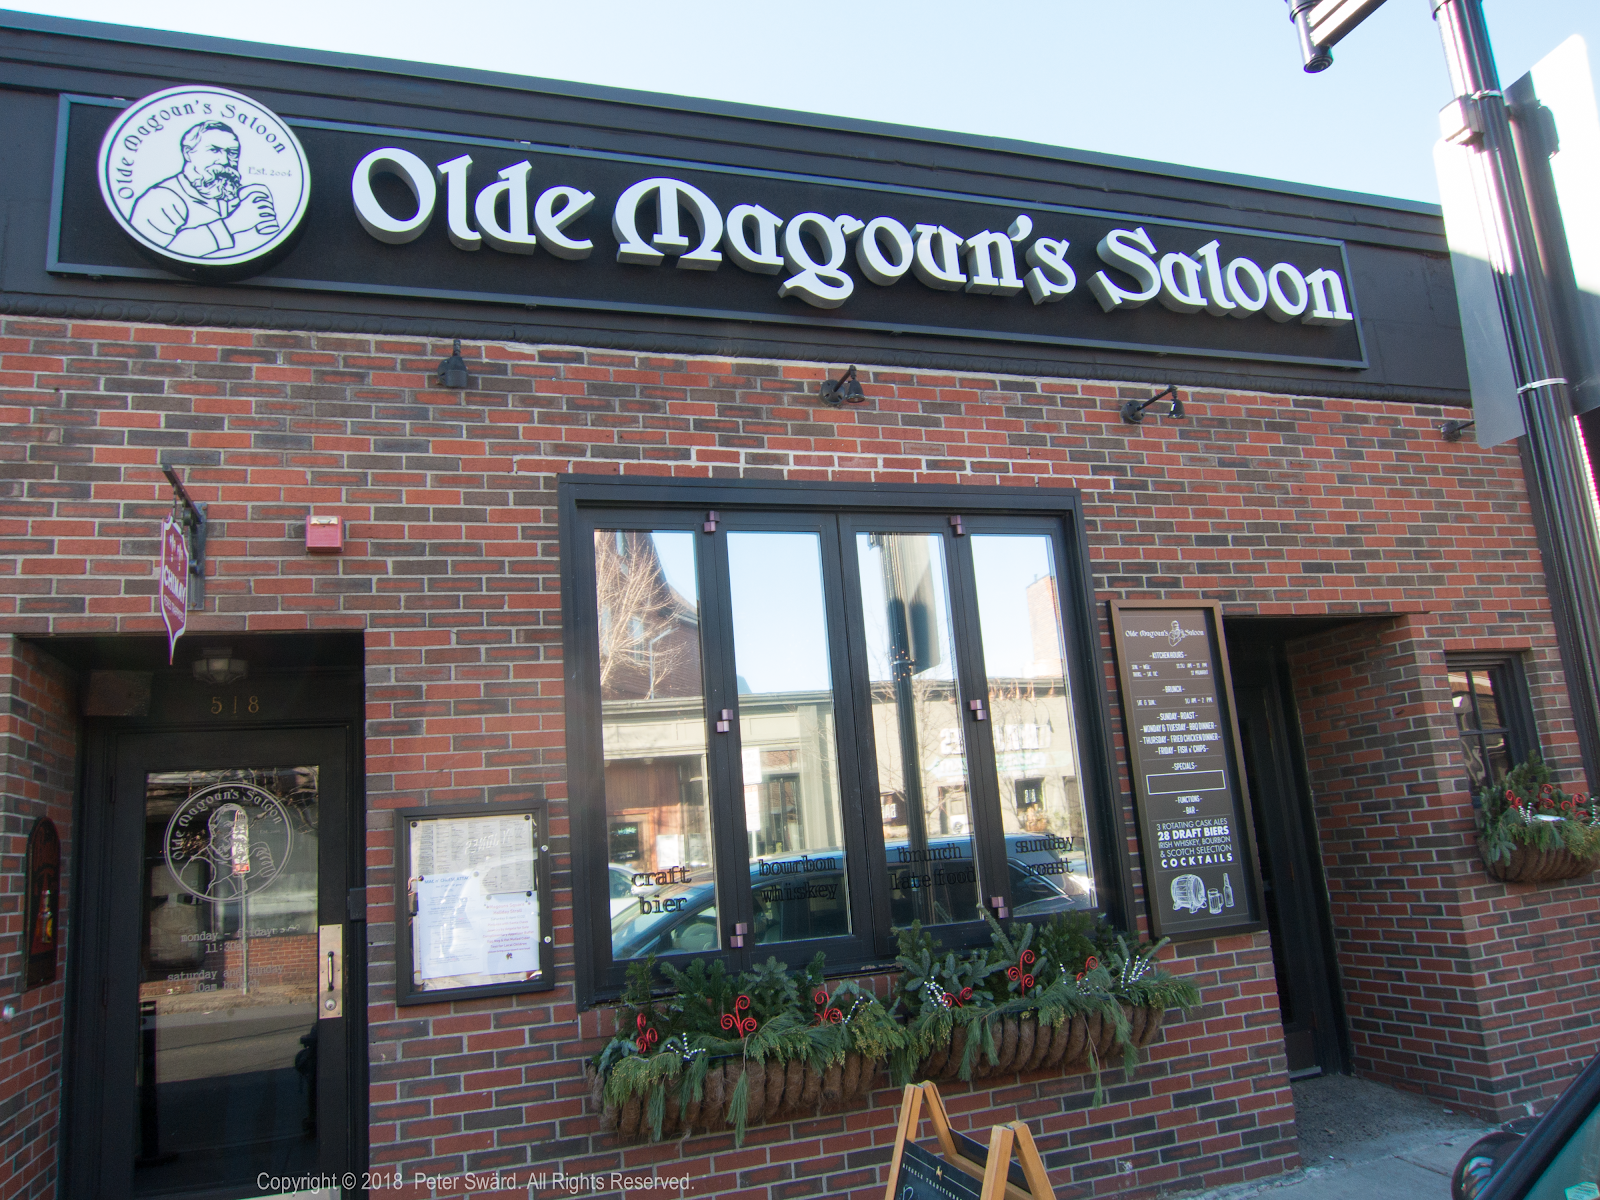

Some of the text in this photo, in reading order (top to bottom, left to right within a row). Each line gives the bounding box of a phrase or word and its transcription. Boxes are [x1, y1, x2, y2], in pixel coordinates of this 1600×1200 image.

[116, 156, 135, 200] Olde
[220, 103, 286, 154] Saloon
[248, 166, 293, 177] Est. 2004
[351, 147, 1353, 327] Olde Magoun's Saloon
[242, 790, 283, 825] Saloon
[1162, 821, 1194, 830] ROTATING
[1195, 819, 1212, 828] CASK
[1214, 818, 1228, 826] ALES
[1158, 826, 1230, 841] 28 DRAFT BIERS
[1202, 836, 1231, 845] BOURBON
[1167, 848, 1195, 857] SCOTCH
[1196, 844, 1232, 855] SELECTION
[758, 855, 837, 876] bourbon
[1161, 852, 1234, 868] COCKTAILS
[631, 865, 692, 888] craft
[761, 880, 838, 905] whiskey
[639, 894, 687, 916] bier
[180, 931, 218, 943] monday
[167, 969, 218, 982] saturday
[223, 979, 260, 990] bruch
